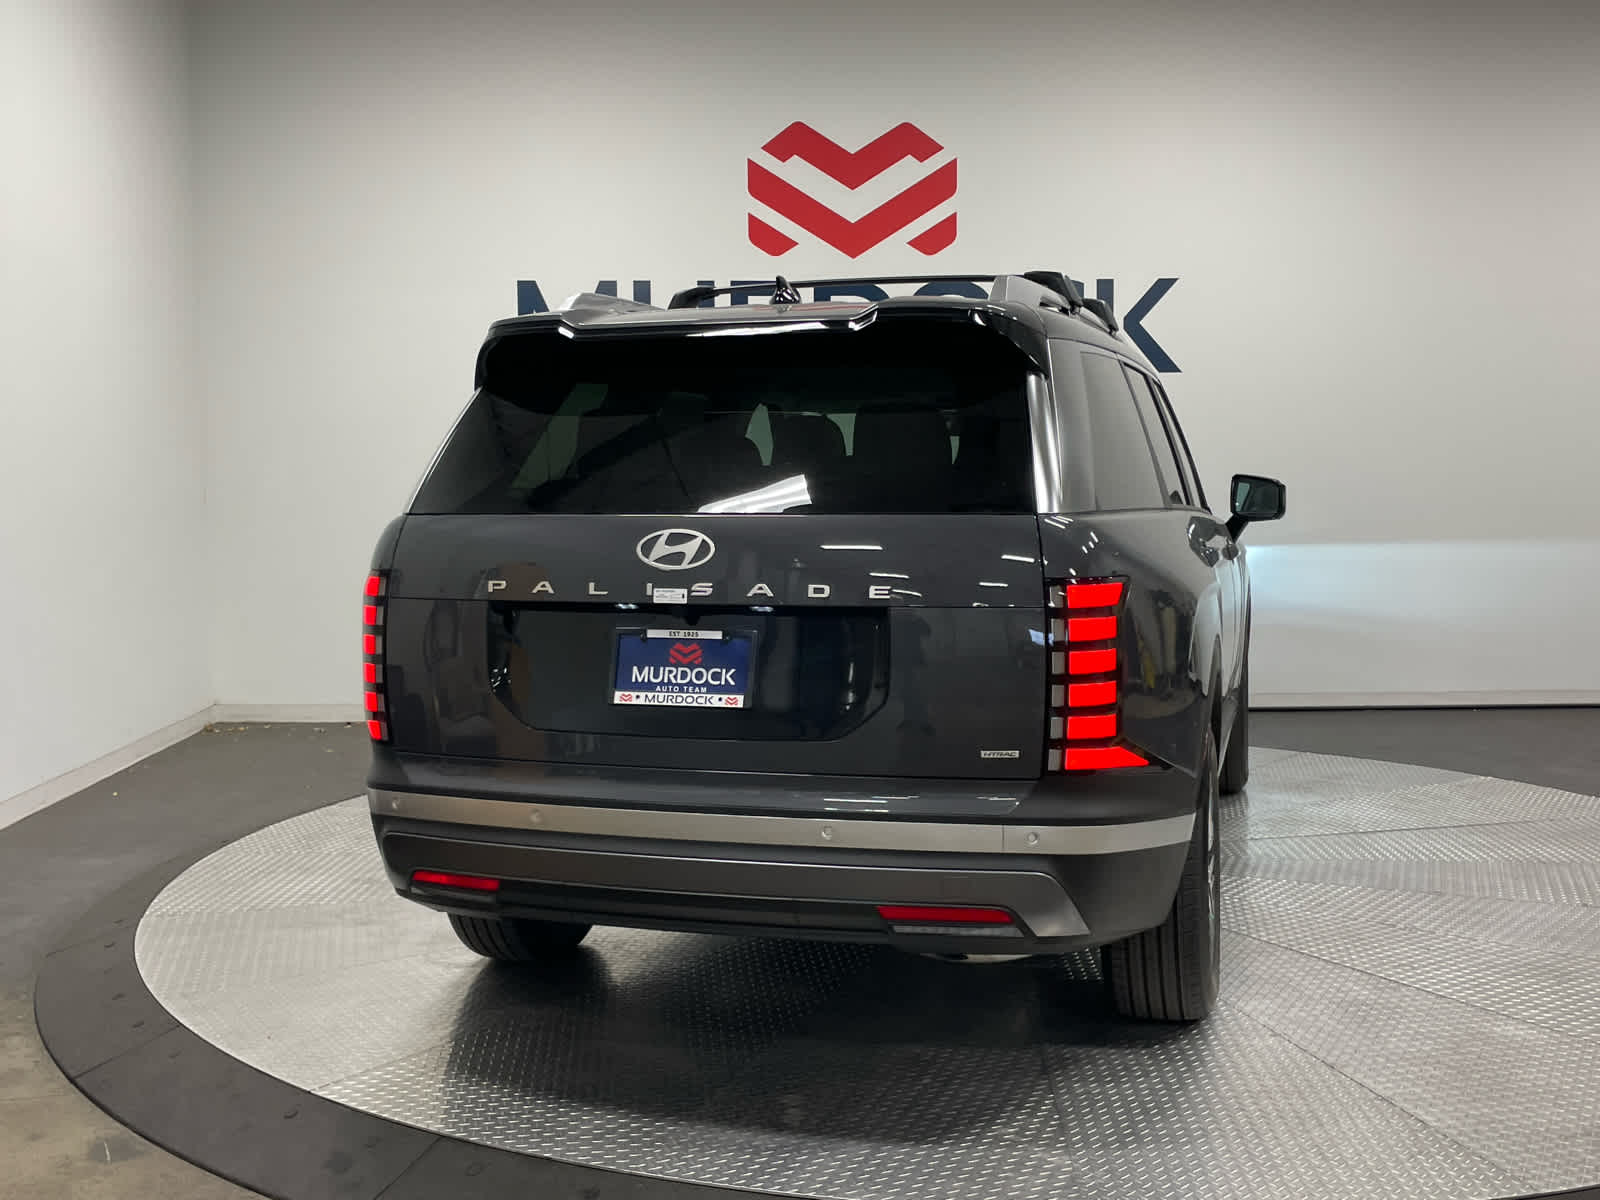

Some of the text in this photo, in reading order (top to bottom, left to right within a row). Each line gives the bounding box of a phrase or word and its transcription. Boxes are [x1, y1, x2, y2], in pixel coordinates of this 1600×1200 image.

[487, 580, 892, 598] PALISADE
[631, 665, 736, 686] MURDOCK
[644, 694, 714, 705] MURDOCK
